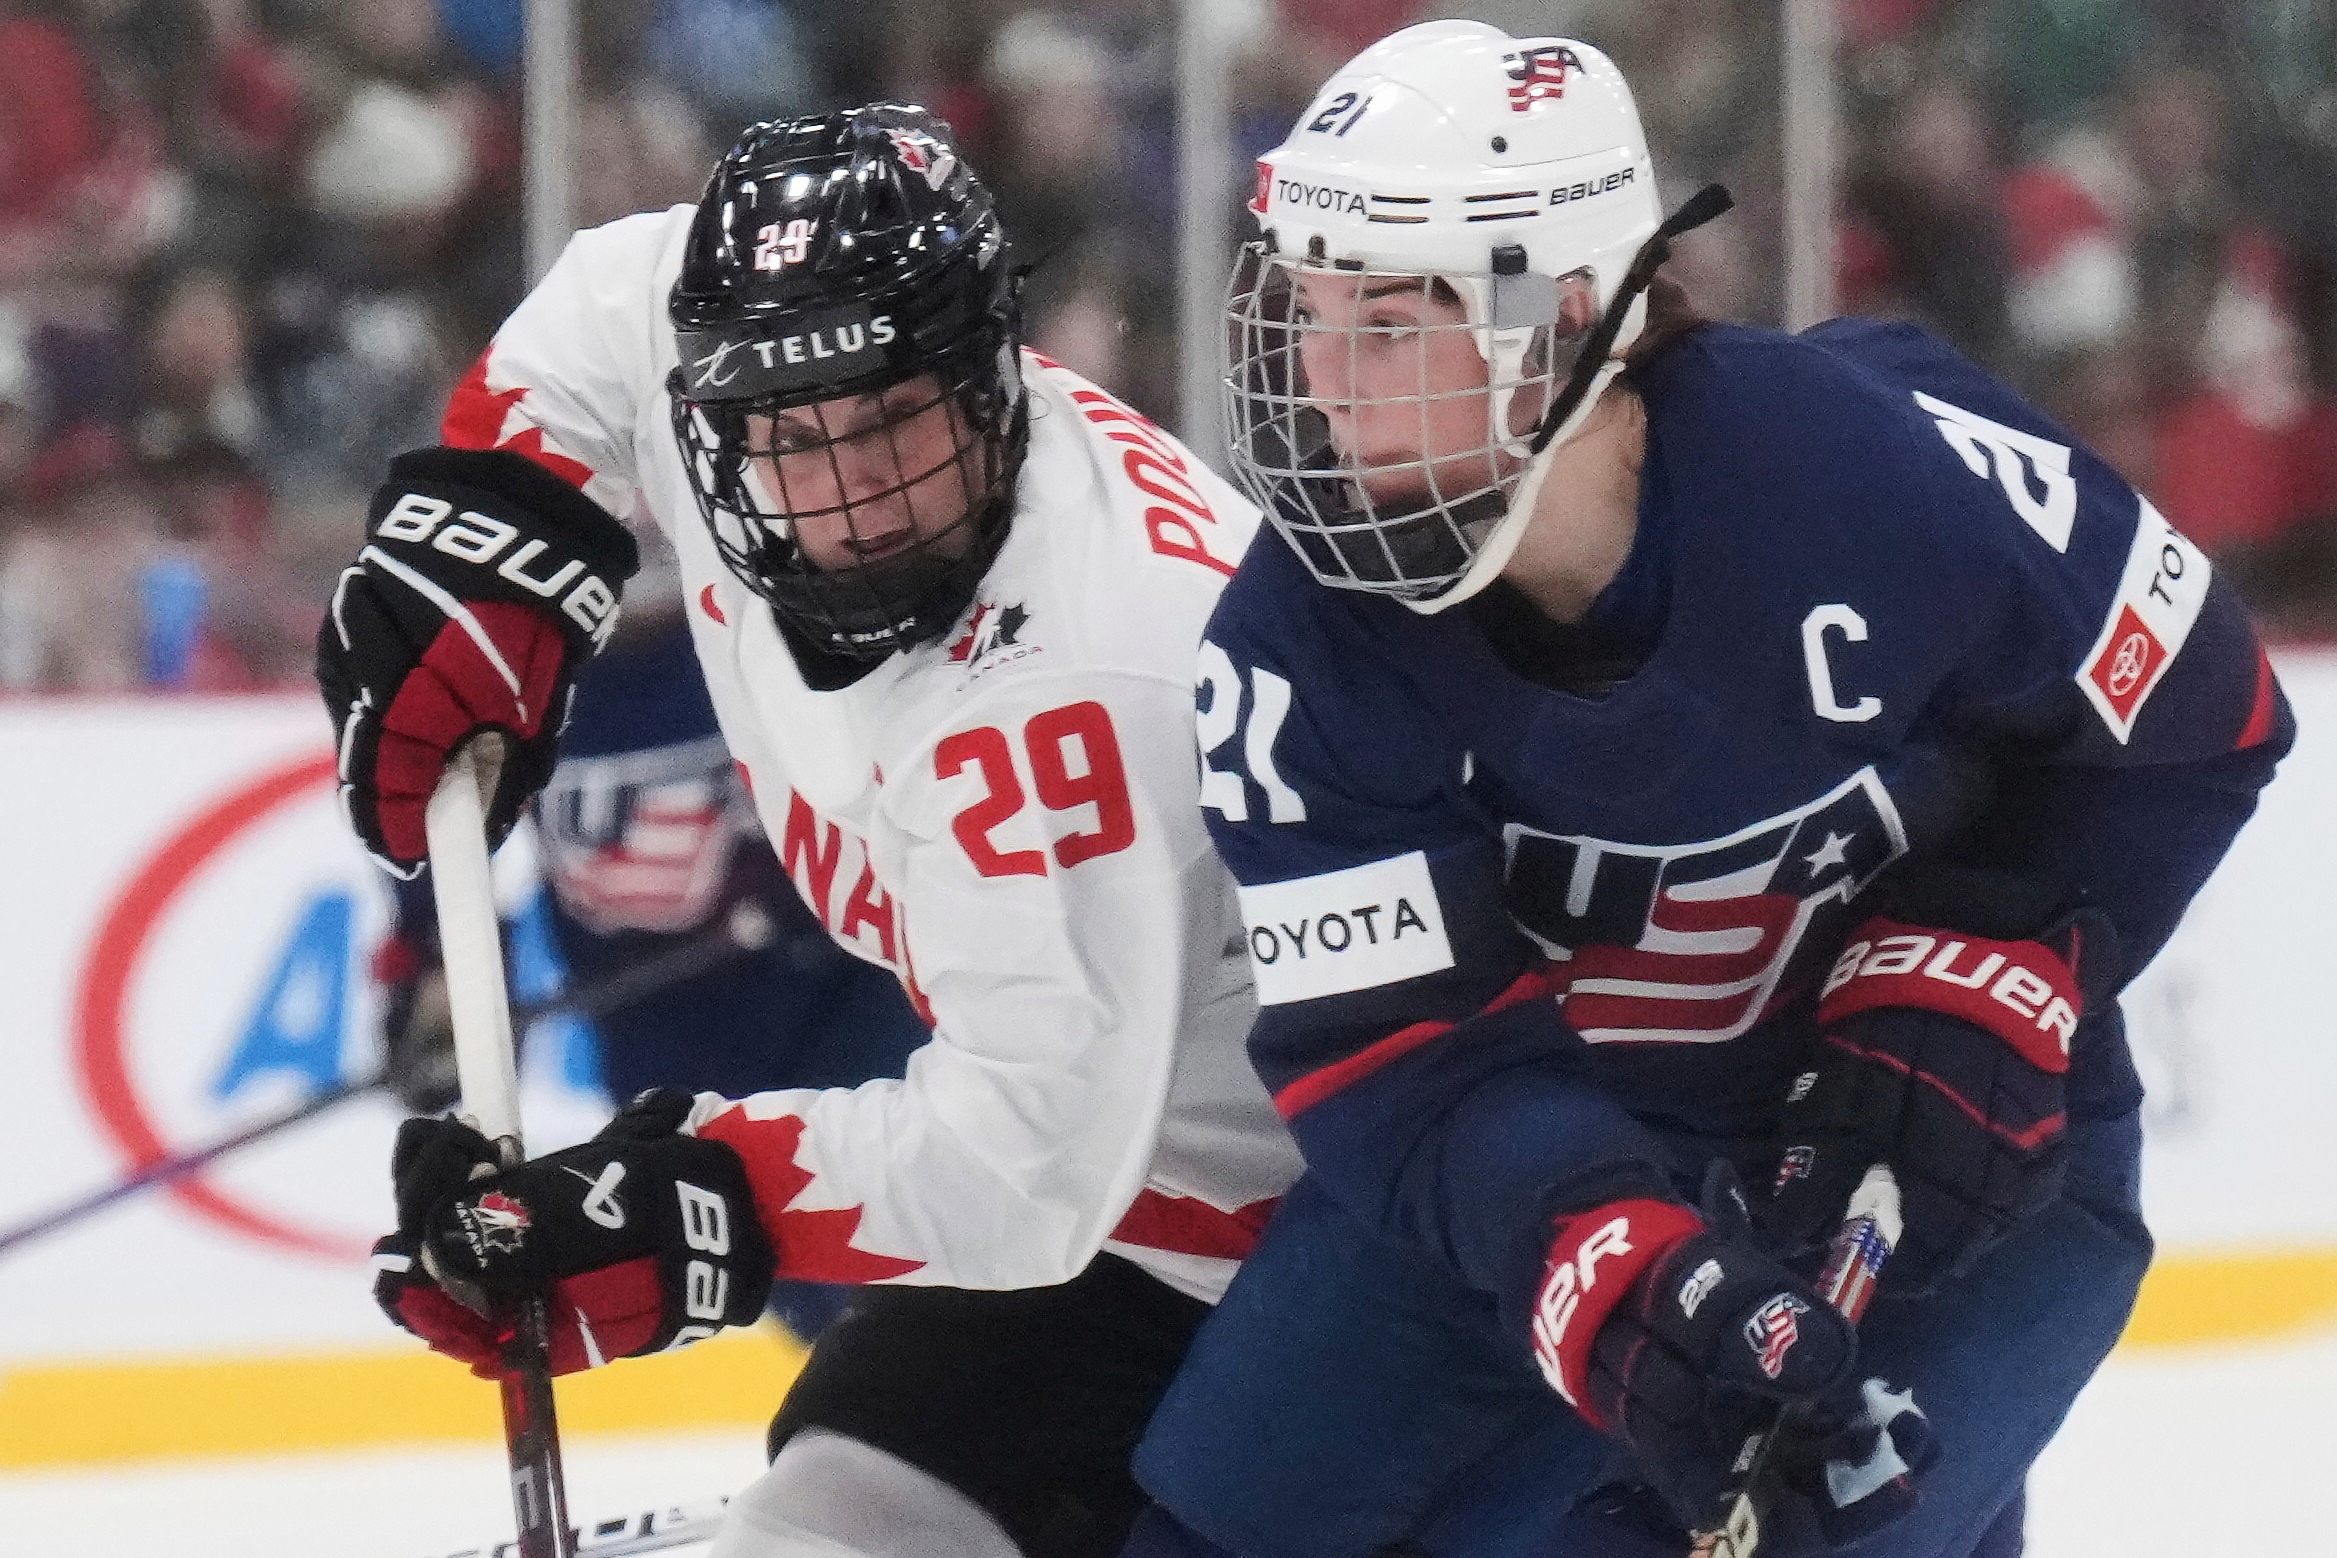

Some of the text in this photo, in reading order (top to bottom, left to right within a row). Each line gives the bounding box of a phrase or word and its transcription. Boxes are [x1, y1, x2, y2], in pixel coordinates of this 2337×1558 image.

[1307, 90, 1374, 138] 21
[1277, 179, 1368, 216] TOYOTA
[1549, 167, 1635, 207] BAUER
[753, 315, 896, 369] TELUS
[2150, 529, 2186, 607] TO
[1801, 604, 1883, 723] C
[934, 700, 1135, 878] 29
